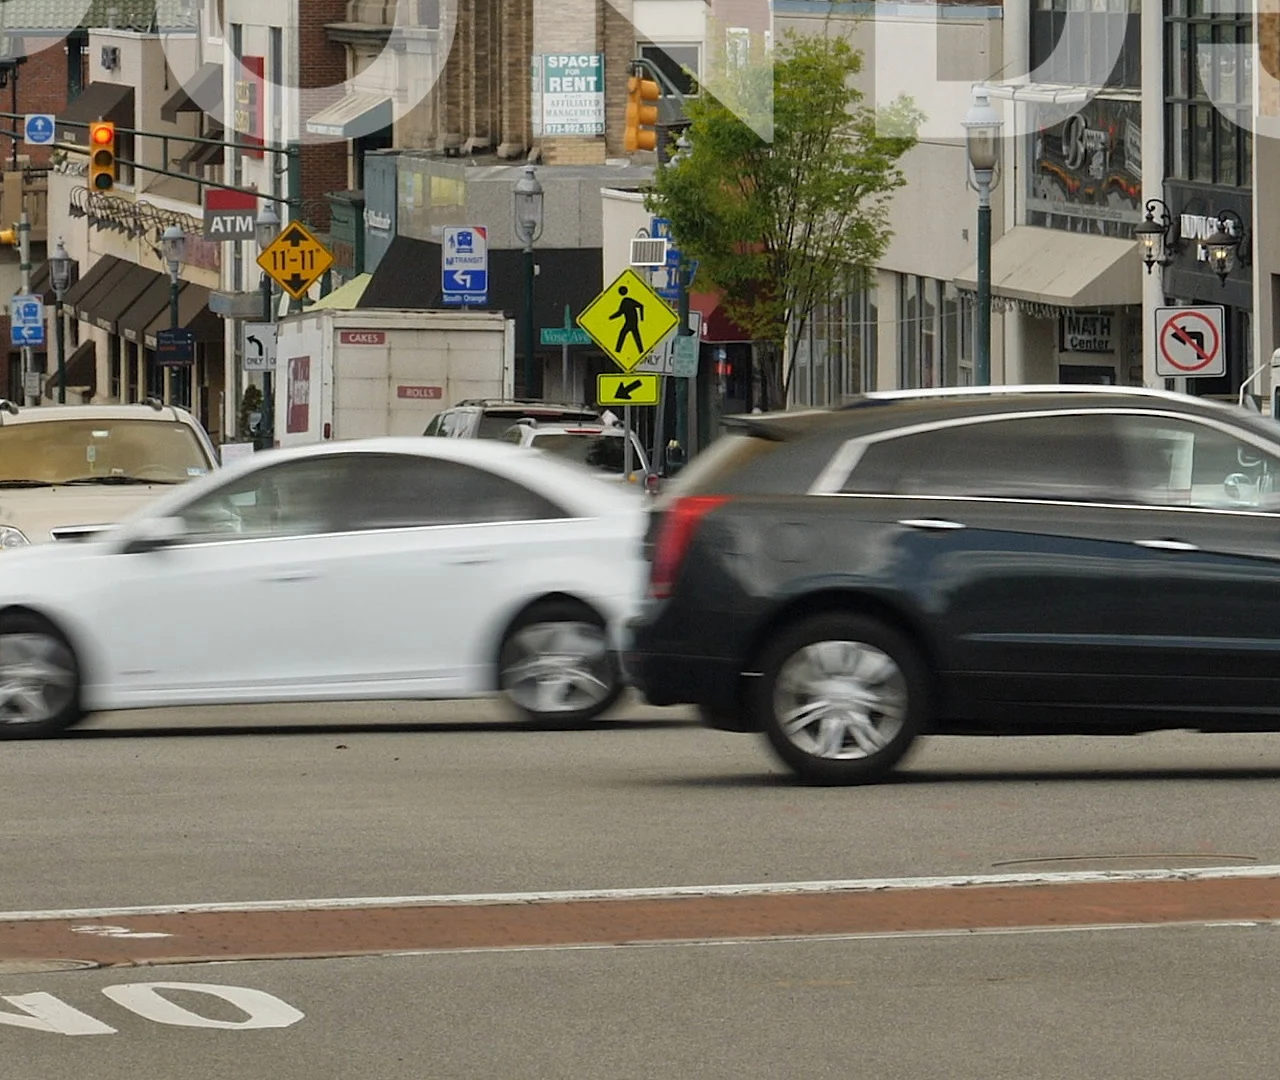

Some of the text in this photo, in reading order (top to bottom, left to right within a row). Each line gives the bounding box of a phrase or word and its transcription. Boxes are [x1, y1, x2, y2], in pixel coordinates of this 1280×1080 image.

[547, 55, 600, 68] SPACE
[564, 68, 580, 76] FOR
[548, 76, 598, 92] RENT
[550, 100, 600, 108] AFFILIATED
[545, 108, 603, 117] MANAGEMENT
[210, 215, 254, 233] ATM
[453, 256, 484, 264] TRANSIT
[463, 294, 487, 304] Orange
[1067, 316, 1111, 336] MATH
[348, 333, 379, 343] CAKES
[543, 329, 568, 342] Vose
[1070, 335, 1110, 349] Center
[246, 357, 265, 365] ONLY
[405, 387, 434, 398] ROLLS
